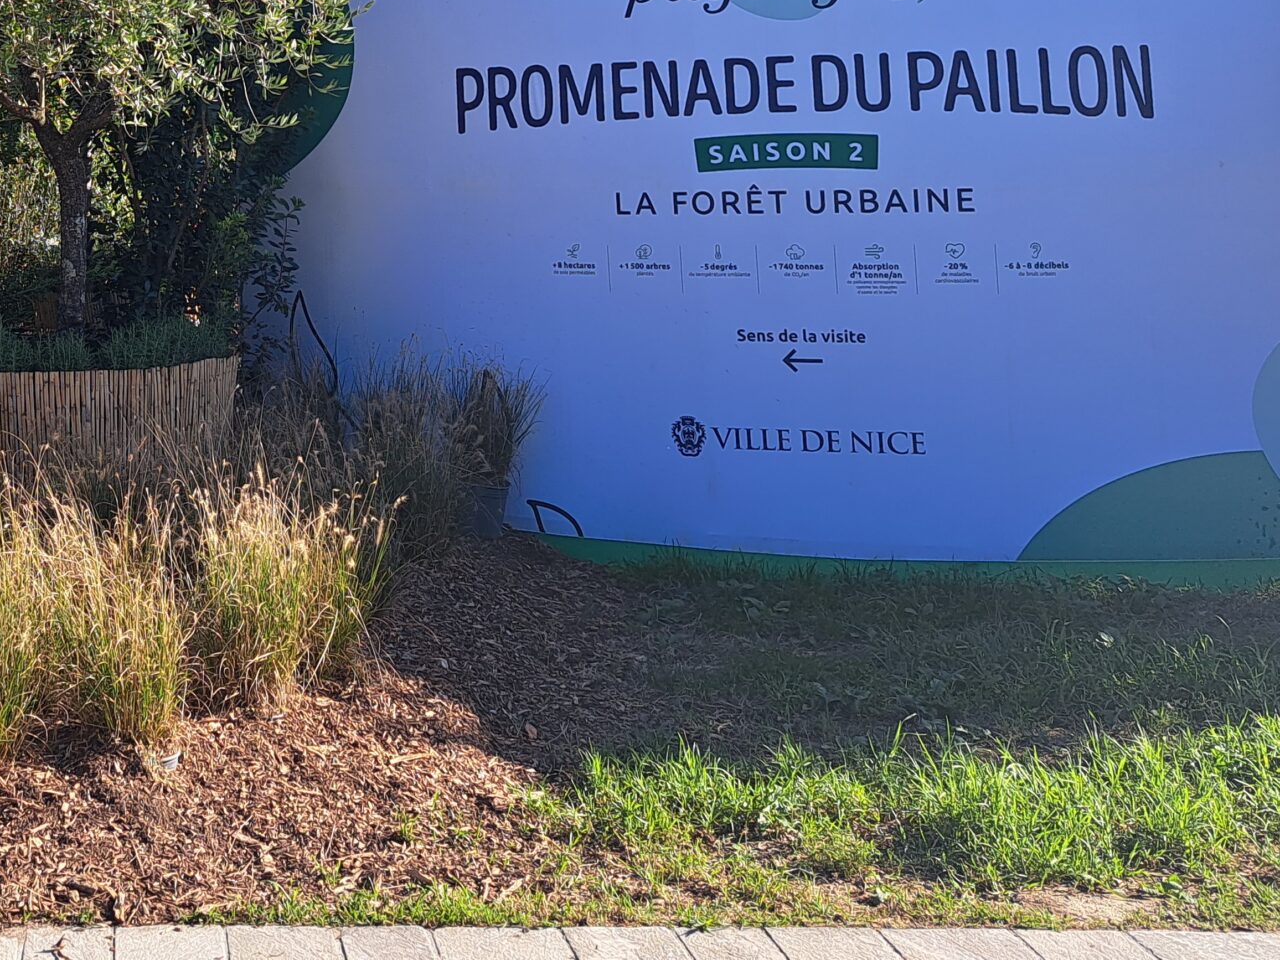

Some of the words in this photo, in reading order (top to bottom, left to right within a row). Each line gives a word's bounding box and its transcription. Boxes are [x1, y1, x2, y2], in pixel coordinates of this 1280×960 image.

[455, 54, 797, 134] PROMENADE
[811, 52, 892, 113] DU
[907, 44, 1154, 119] PAILLON
[708, 141, 831, 164] SAISON
[849, 142, 864, 162] 2
[615, 191, 657, 215] LA
[672, 184, 788, 214] FORÊT
[804, 187, 976, 214] URBAINE
[563, 261, 596, 269] hectares
[852, 262, 899, 271] Absorption
[1034, 261, 1069, 269] décibels
[864, 271, 903, 280] tonne/an
[737, 329, 774, 343] Sens
[778, 329, 798, 343] de
[802, 329, 817, 343] la
[821, 329, 866, 344] visite
[710, 427, 792, 452] VILLE
[799, 429, 841, 453] DE
[850, 431, 927, 455] NICE
